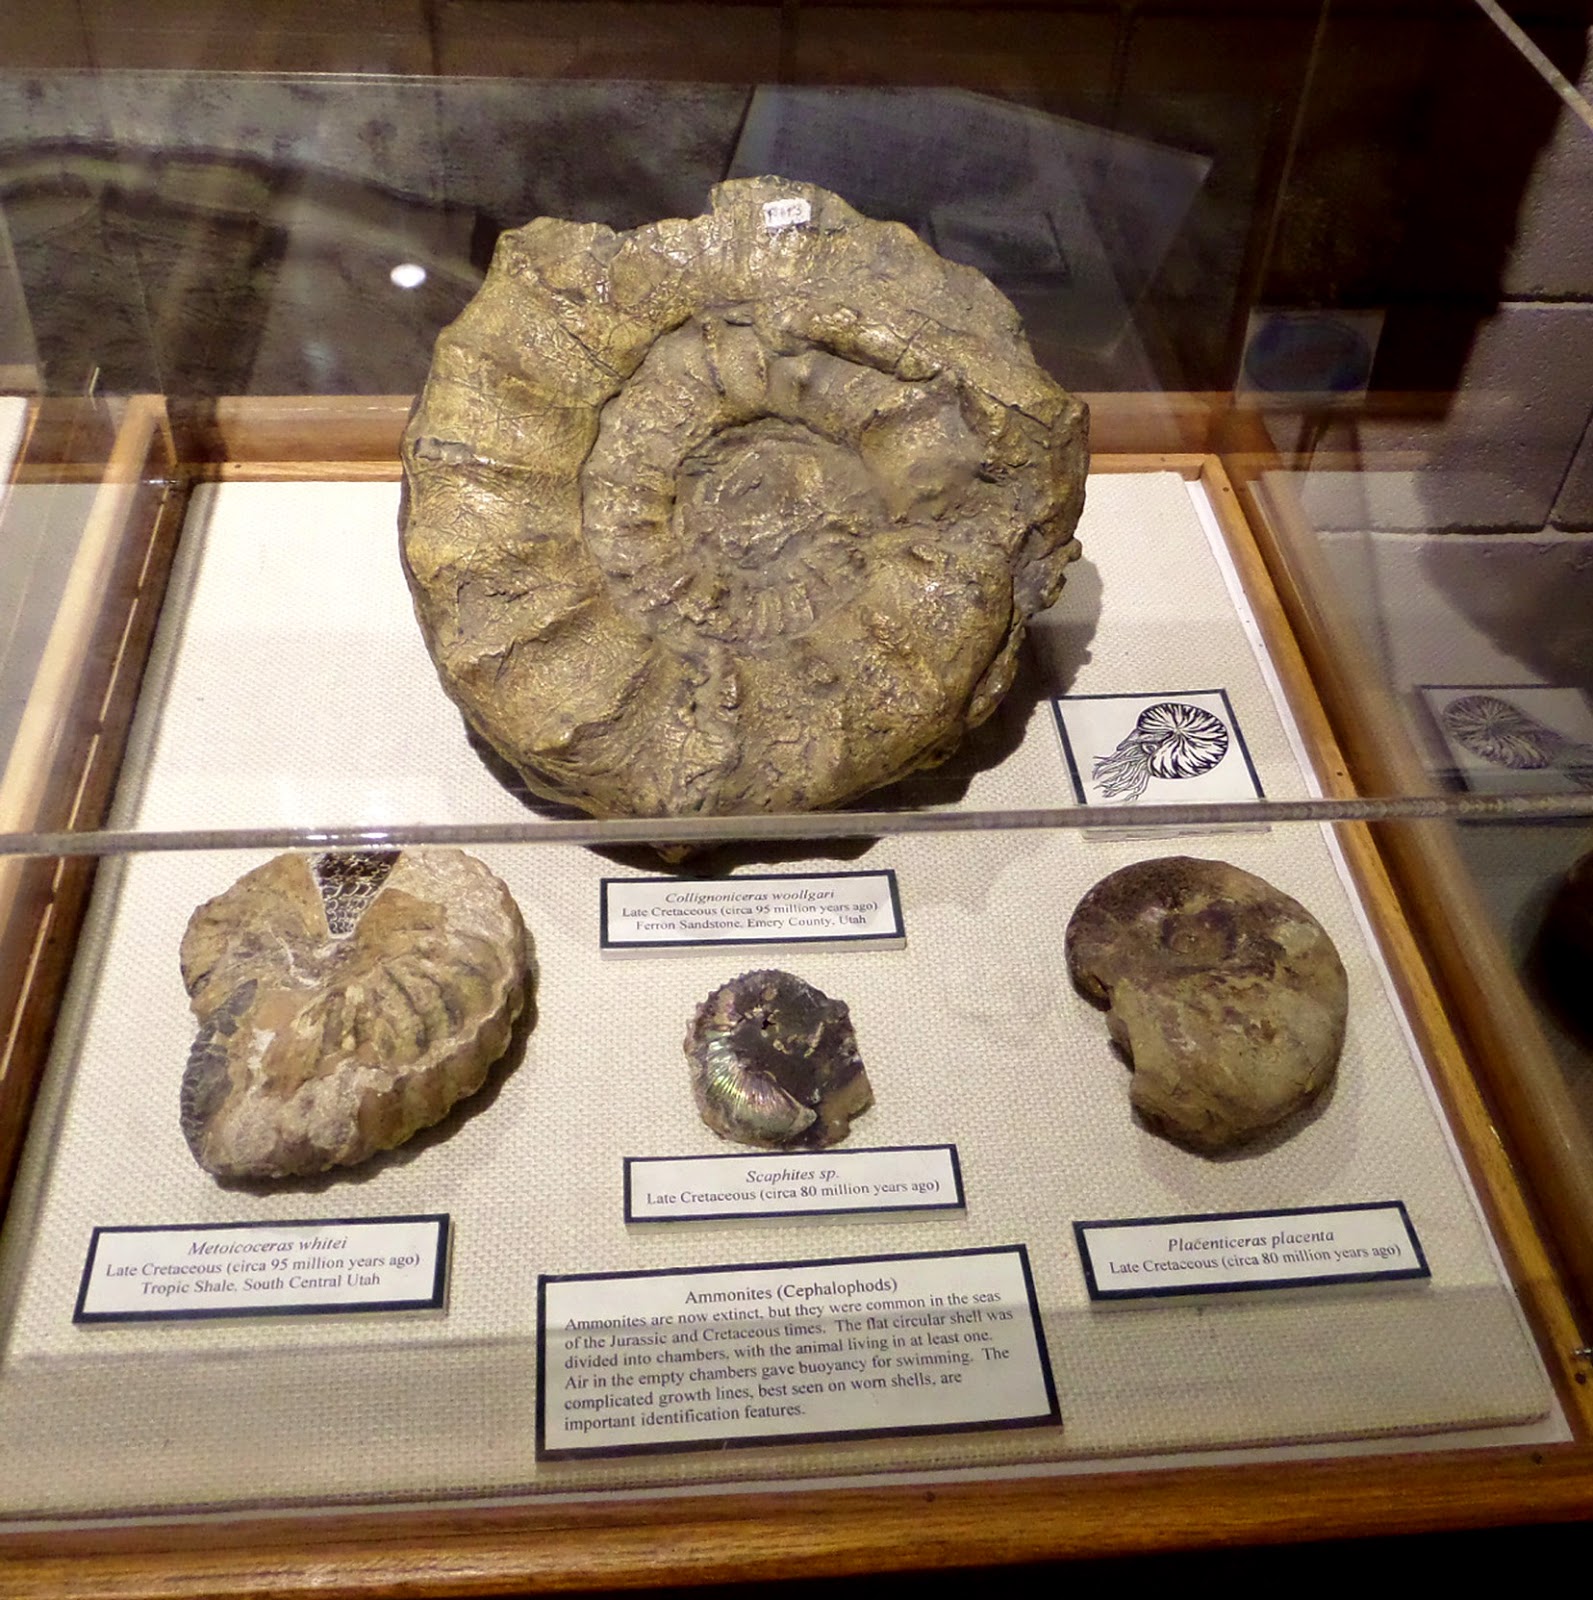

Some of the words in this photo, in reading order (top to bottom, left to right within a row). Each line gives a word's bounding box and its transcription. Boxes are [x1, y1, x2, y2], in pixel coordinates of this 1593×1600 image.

[622, 908, 648, 917] Late
[650, 906, 717, 917] Cretaceous
[719, 905, 753, 916] (circa
[755, 904, 771, 914] 95
[773, 903, 816, 913] million
[819, 904, 850, 914] years
[852, 901, 878, 913] ago)
[664, 892, 768, 906] Collignoniceras
[771, 890, 834, 903] woollgari
[636, 921, 675, 931] Ferron
[747, 918, 784, 930] Emery
[838, 915, 867, 925] Utah
[745, 1167, 815, 1186] Scaphites
[647, 1193, 676, 1205] Late
[680, 1189, 756, 1203] Cretaceous
[759, 1187, 797, 1202] (circa
[799, 1186, 817, 1198] 80
[820, 1184, 870, 1197] million
[873, 1185, 908, 1197] years
[911, 1181, 940, 1195] ago)
[187, 1239, 294, 1256] Metoicoceras
[299, 1237, 348, 1251] whitei
[1168, 1233, 1267, 1252] Placenticeras
[1271, 1229, 1334, 1248] placenta
[105, 1264, 138, 1277] Late
[141, 1261, 222, 1276] Cretaceous
[226, 1259, 266, 1275] (circa
[270, 1258, 288, 1271] 95
[292, 1256, 344, 1270] million
[347, 1258, 385, 1271] years
[388, 1253, 420, 1269] ago)
[1109, 1260, 1139, 1275] Late
[1142, 1255, 1219, 1273] Cretaceous
[1221, 1253, 1260, 1270] (circa
[1261, 1251, 1279, 1265] 80
[1281, 1248, 1331, 1263] million
[1333, 1249, 1369, 1262] years
[1371, 1243, 1401, 1260] ago)
[141, 1281, 189, 1297] Tropic
[242, 1277, 284, 1291] South
[288, 1275, 342, 1289] Central
[346, 1273, 380, 1287] Utah
[685, 1287, 773, 1305] Ammonites
[776, 1277, 897, 1302] (Cephalophods)
[565, 1314, 647, 1331] Ammonites
[651, 1315, 673, 1325] are
[677, 1313, 708, 1323] now
[767, 1304, 791, 1318] but
[794, 1302, 824, 1318] they
[828, 1302, 861, 1314] were
[865, 1298, 925, 1311] common
[929, 1294, 943, 1307] in
[946, 1293, 968, 1306] the
[972, 1293, 1001, 1304] seas
[564, 1337, 582, 1351] of
[583, 1335, 606, 1350] the
[609, 1331, 667, 1348] Jurassic
[671, 1329, 699, 1344] and
[702, 1323, 781, 1342] Cretaceous
[834, 1317, 862, 1333] The
[866, 1316, 889, 1331] flat
[892, 1312, 946, 1329] circular
[949, 1309, 983, 1325] shell
[986, 1311, 1013, 1323] was
[564, 1353, 618, 1370] divided
[623, 1351, 652, 1366] into
[733, 1344, 765, 1359] with
[769, 1342, 792, 1357] the
[794, 1339, 843, 1355] animal
[847, 1336, 889, 1354] living
[892, 1335, 906, 1349] in
[910, 1334, 923, 1348] at
[926, 1331, 960, 1347] least
[564, 1375, 589, 1390] Air
[592, 1374, 607, 1388] in
[610, 1372, 634, 1386] the
[637, 1368, 684, 1387] empty
[688, 1363, 757, 1381] chambers
[761, 1364, 795, 1379] gave
[797, 1356, 866, 1376] buoyancy
[871, 1354, 892, 1369] for
[984, 1347, 1009, 1362] The
[563, 1391, 653, 1412] complicated
[658, 1387, 711, 1406] growth
[757, 1382, 787, 1397] best
[791, 1383, 824, 1395] seen
[827, 1382, 846, 1393] on
[850, 1379, 887, 1391] worn
[940, 1374, 961, 1386] are
[564, 1413, 636, 1433] important
[640, 1407, 740, 1426] identification
